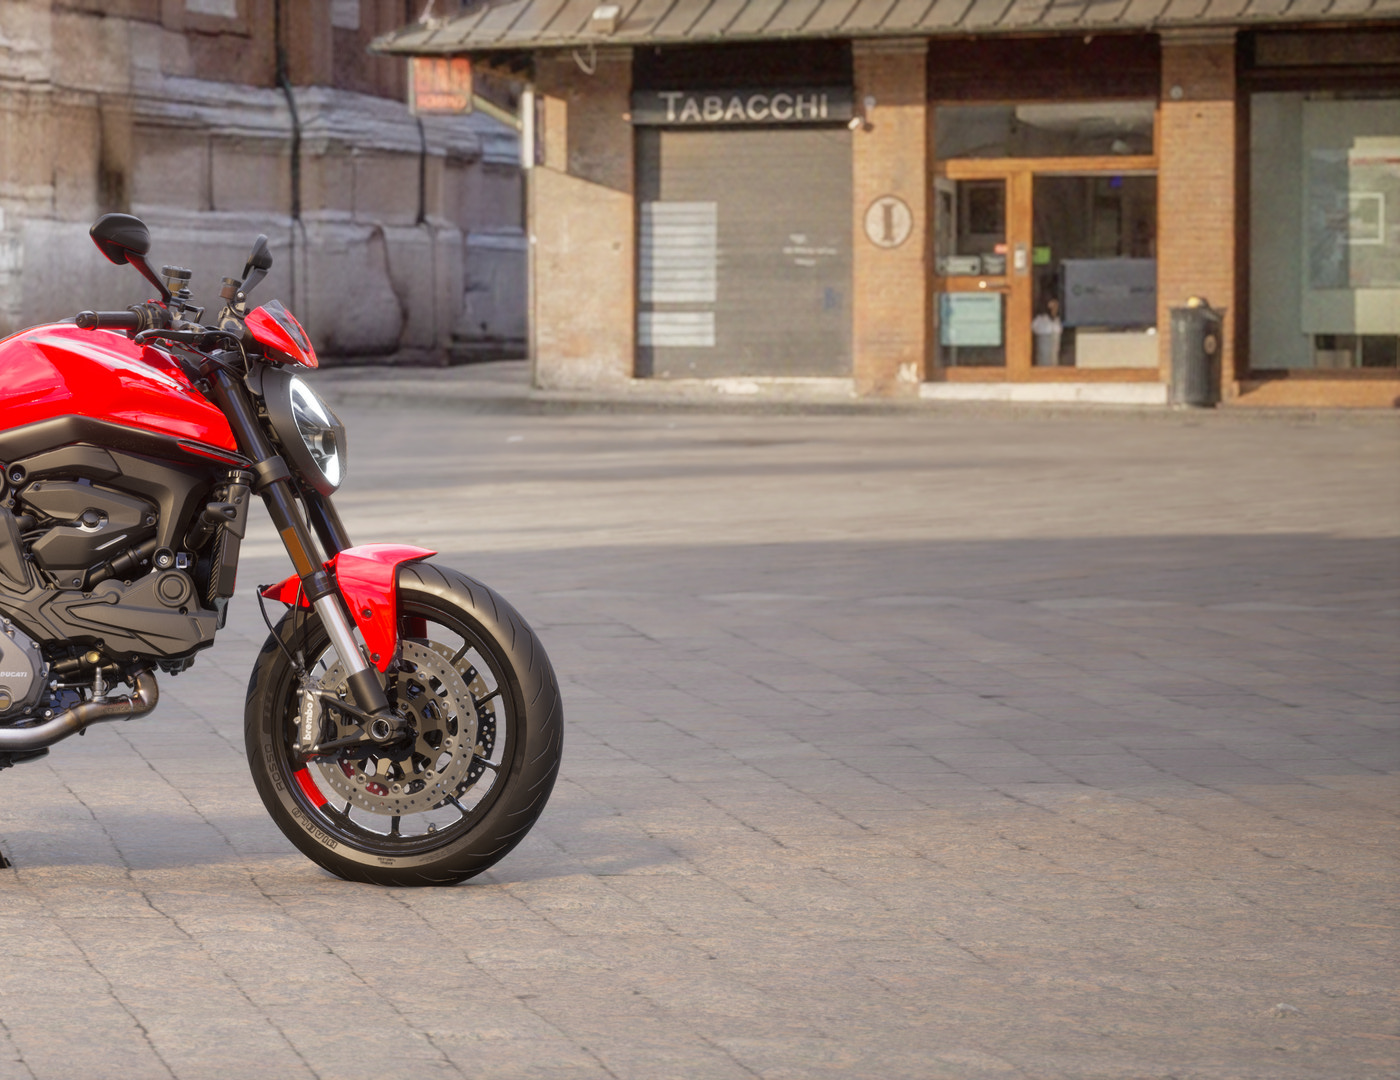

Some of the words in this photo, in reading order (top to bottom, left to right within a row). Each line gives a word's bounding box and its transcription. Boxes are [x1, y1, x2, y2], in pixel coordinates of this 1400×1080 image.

[658, 91, 828, 122] TABACCHI
[303, 702, 313, 741] brembo
[264, 743, 285, 792] ROSSO
[291, 807, 338, 850] DIABLO
